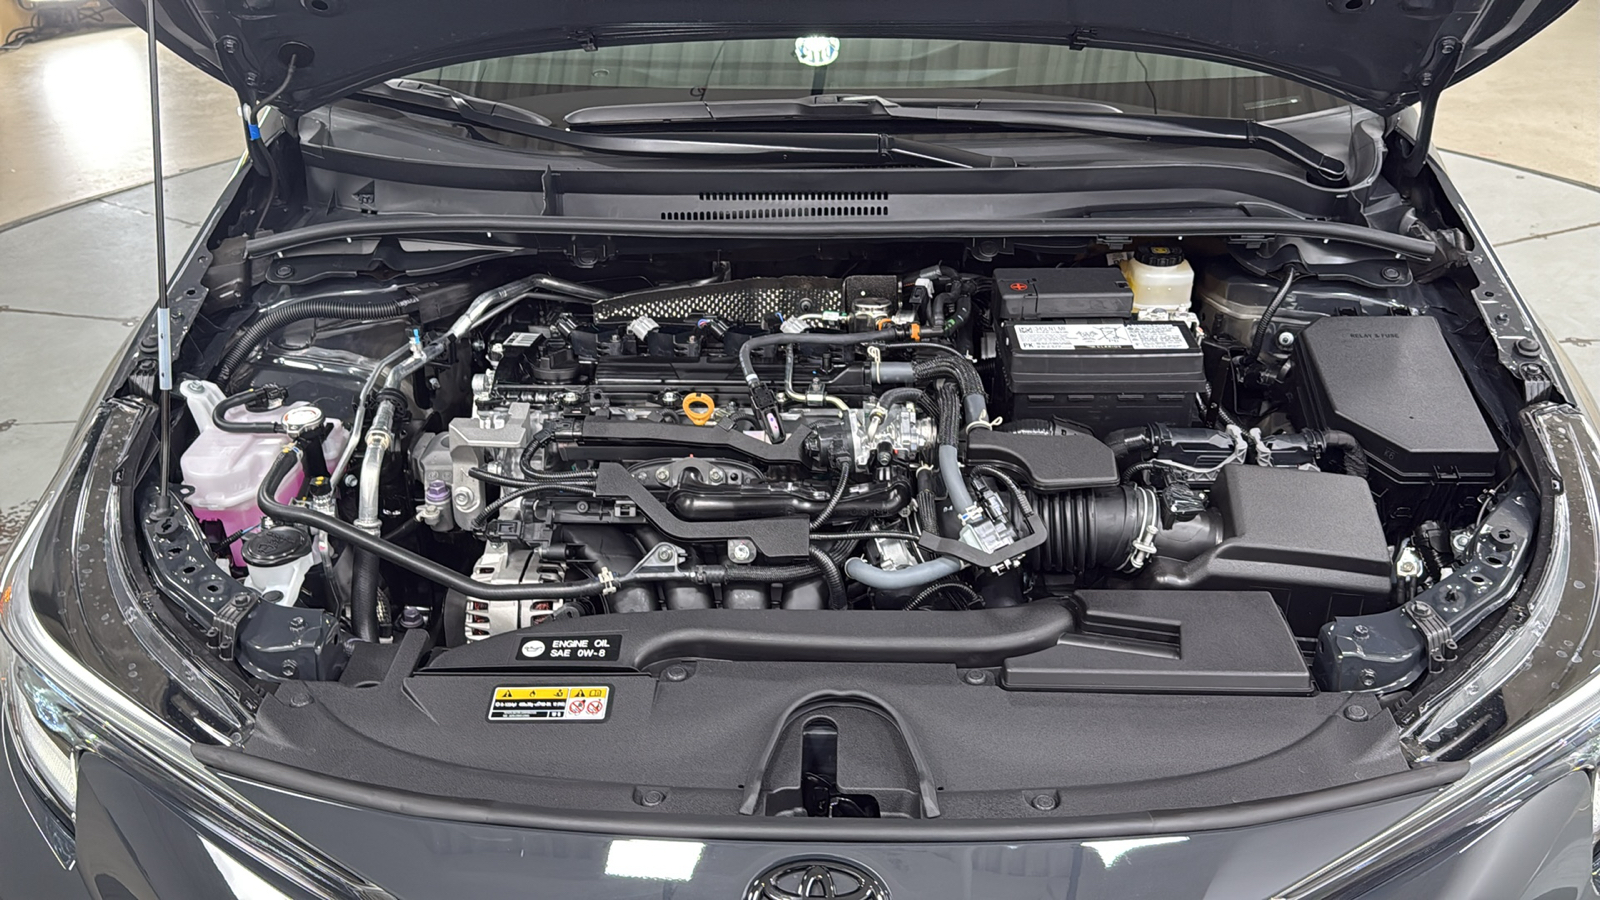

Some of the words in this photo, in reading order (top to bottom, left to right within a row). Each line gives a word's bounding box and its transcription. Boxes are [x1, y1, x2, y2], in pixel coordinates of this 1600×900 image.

[552, 640, 589, 648] ENGINE
[594, 639, 610, 647] OIL
[550, 649, 571, 657] SAE
[577, 649, 606, 657] 0W-8
